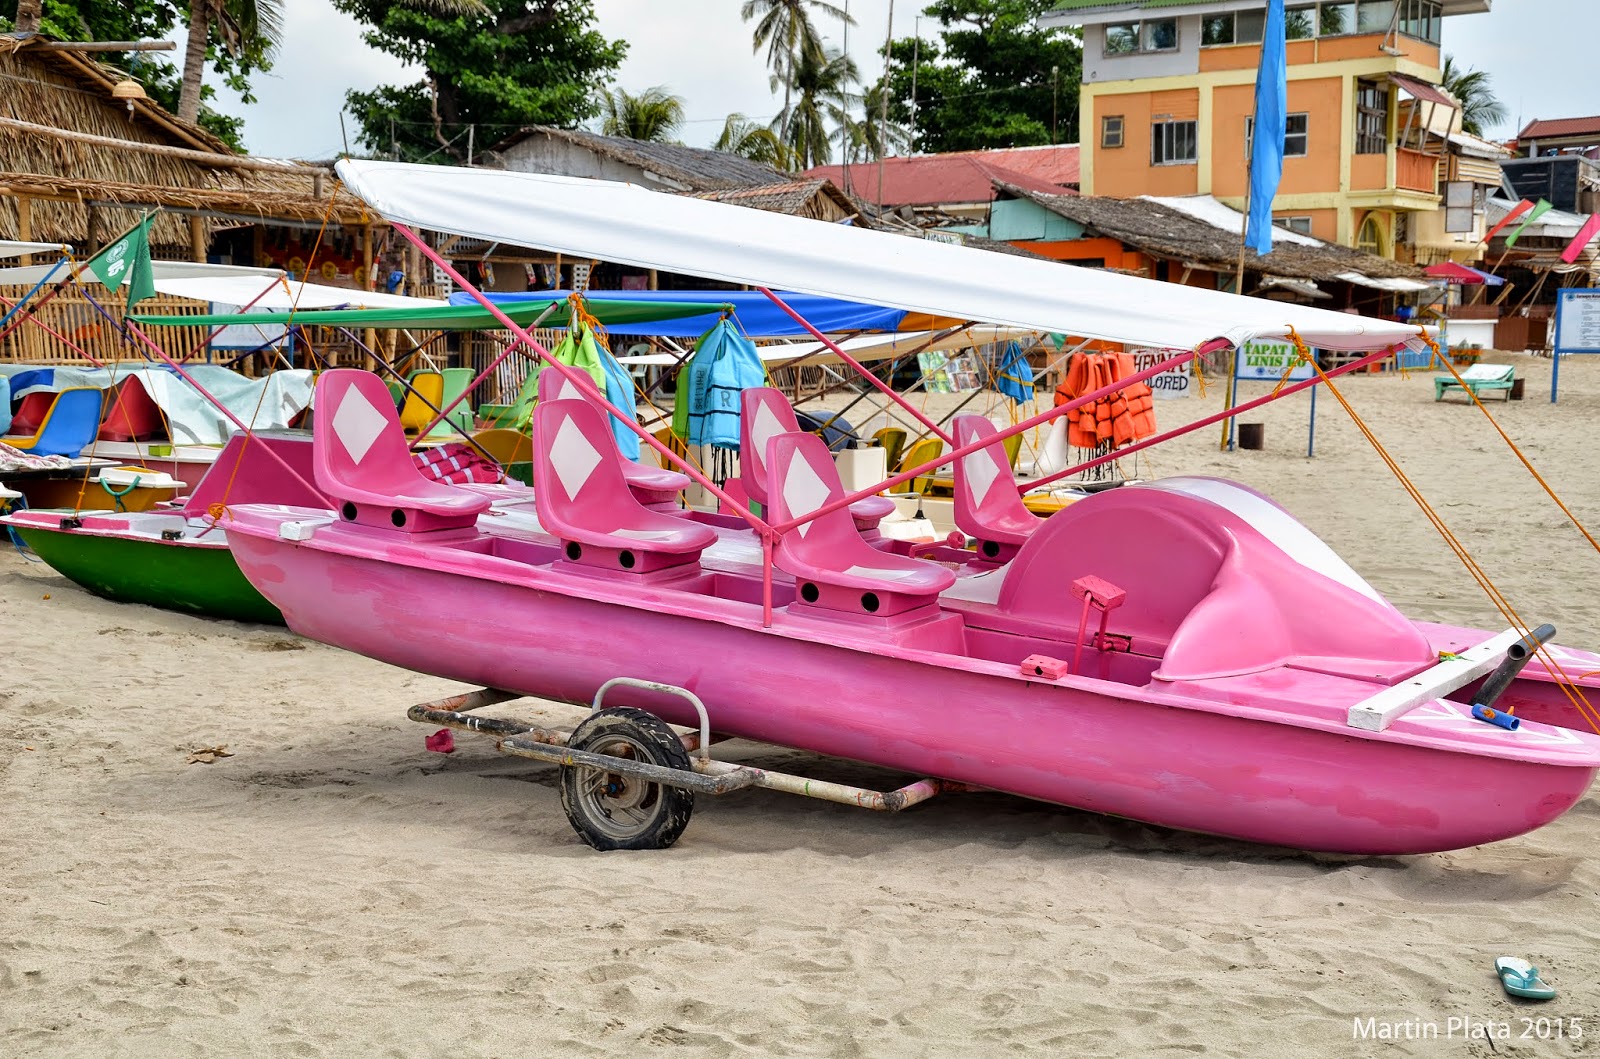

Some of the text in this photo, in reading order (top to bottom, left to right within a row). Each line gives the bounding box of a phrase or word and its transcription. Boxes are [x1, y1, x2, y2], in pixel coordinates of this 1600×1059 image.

[1243, 343, 1288, 355] TAPAT
[1246, 356, 1283, 367] LINIS
[1142, 375, 1189, 391] OLORED
